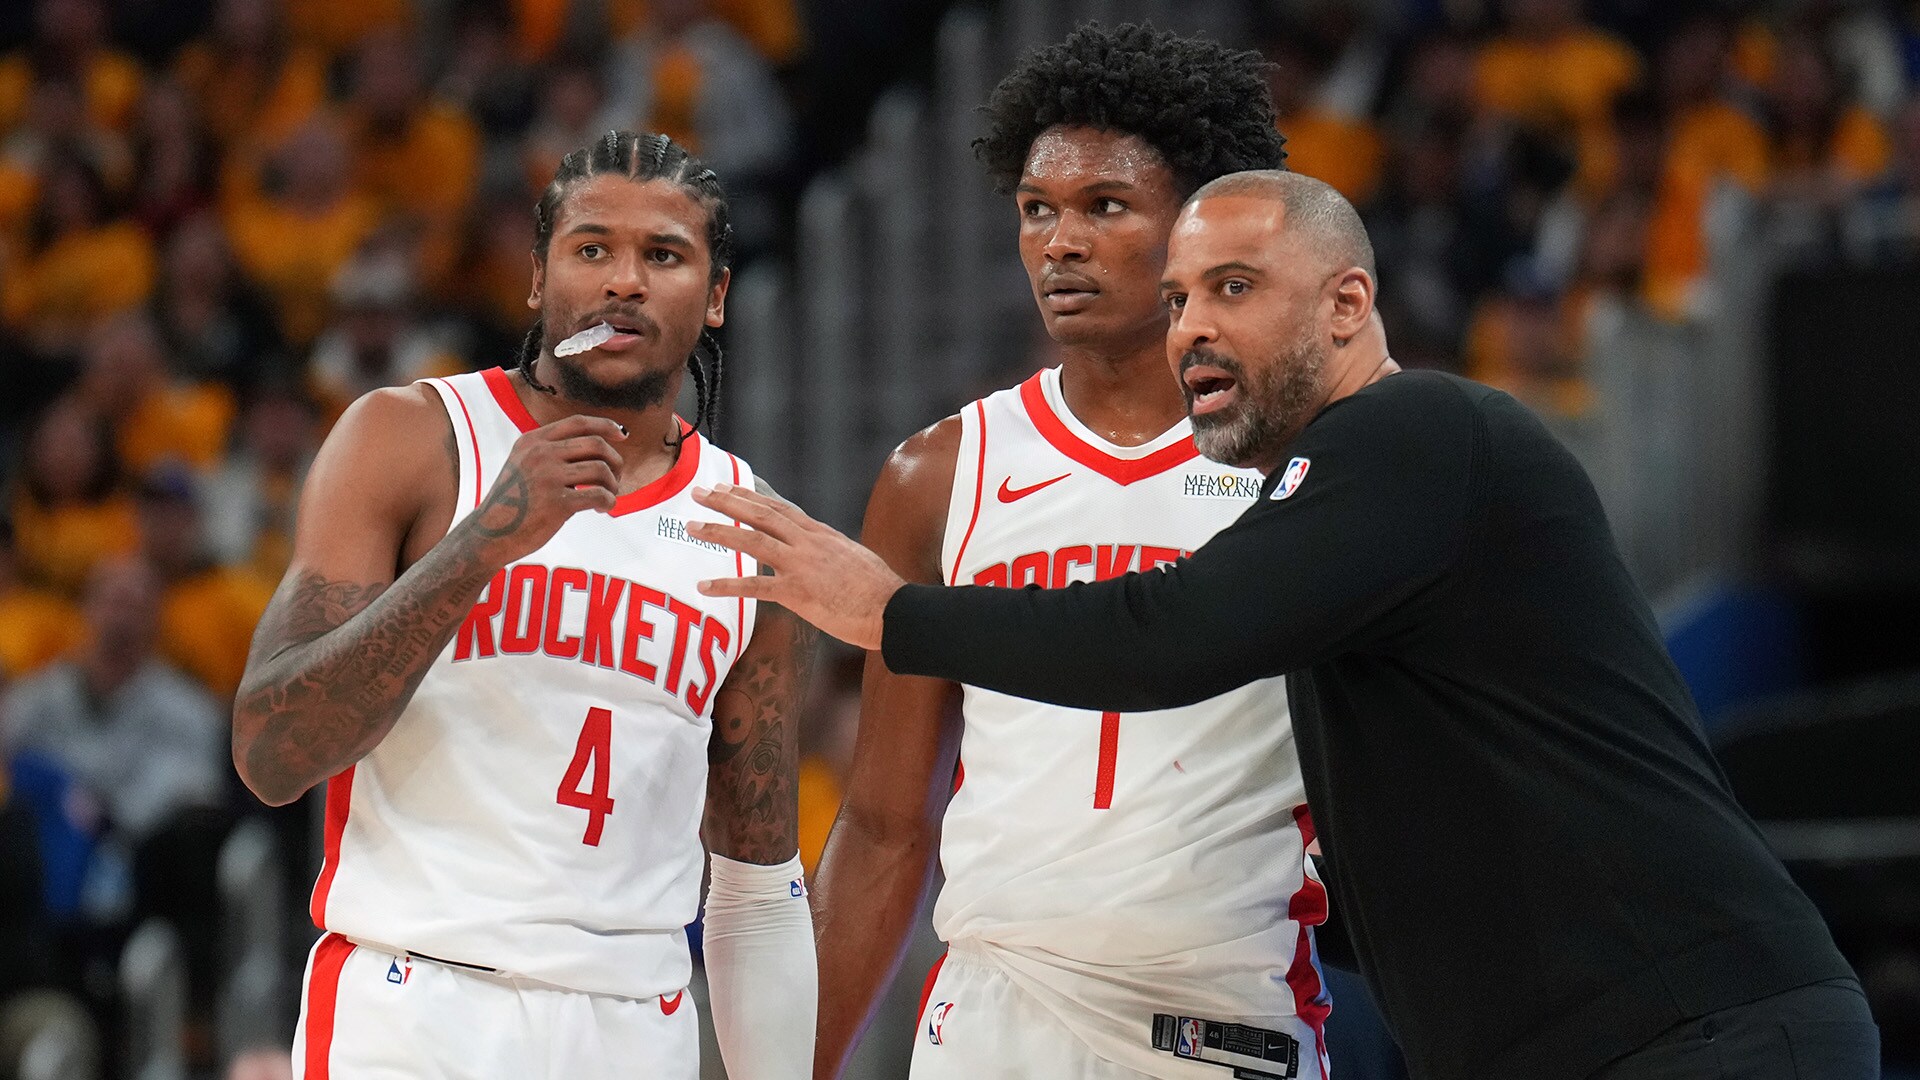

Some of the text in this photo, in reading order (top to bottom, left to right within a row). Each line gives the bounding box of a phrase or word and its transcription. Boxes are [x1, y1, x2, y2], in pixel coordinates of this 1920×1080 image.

[1185, 474, 1264, 489] MEMORIA
[451, 563, 731, 719] ROCKETS
[556, 706, 616, 848] 4
